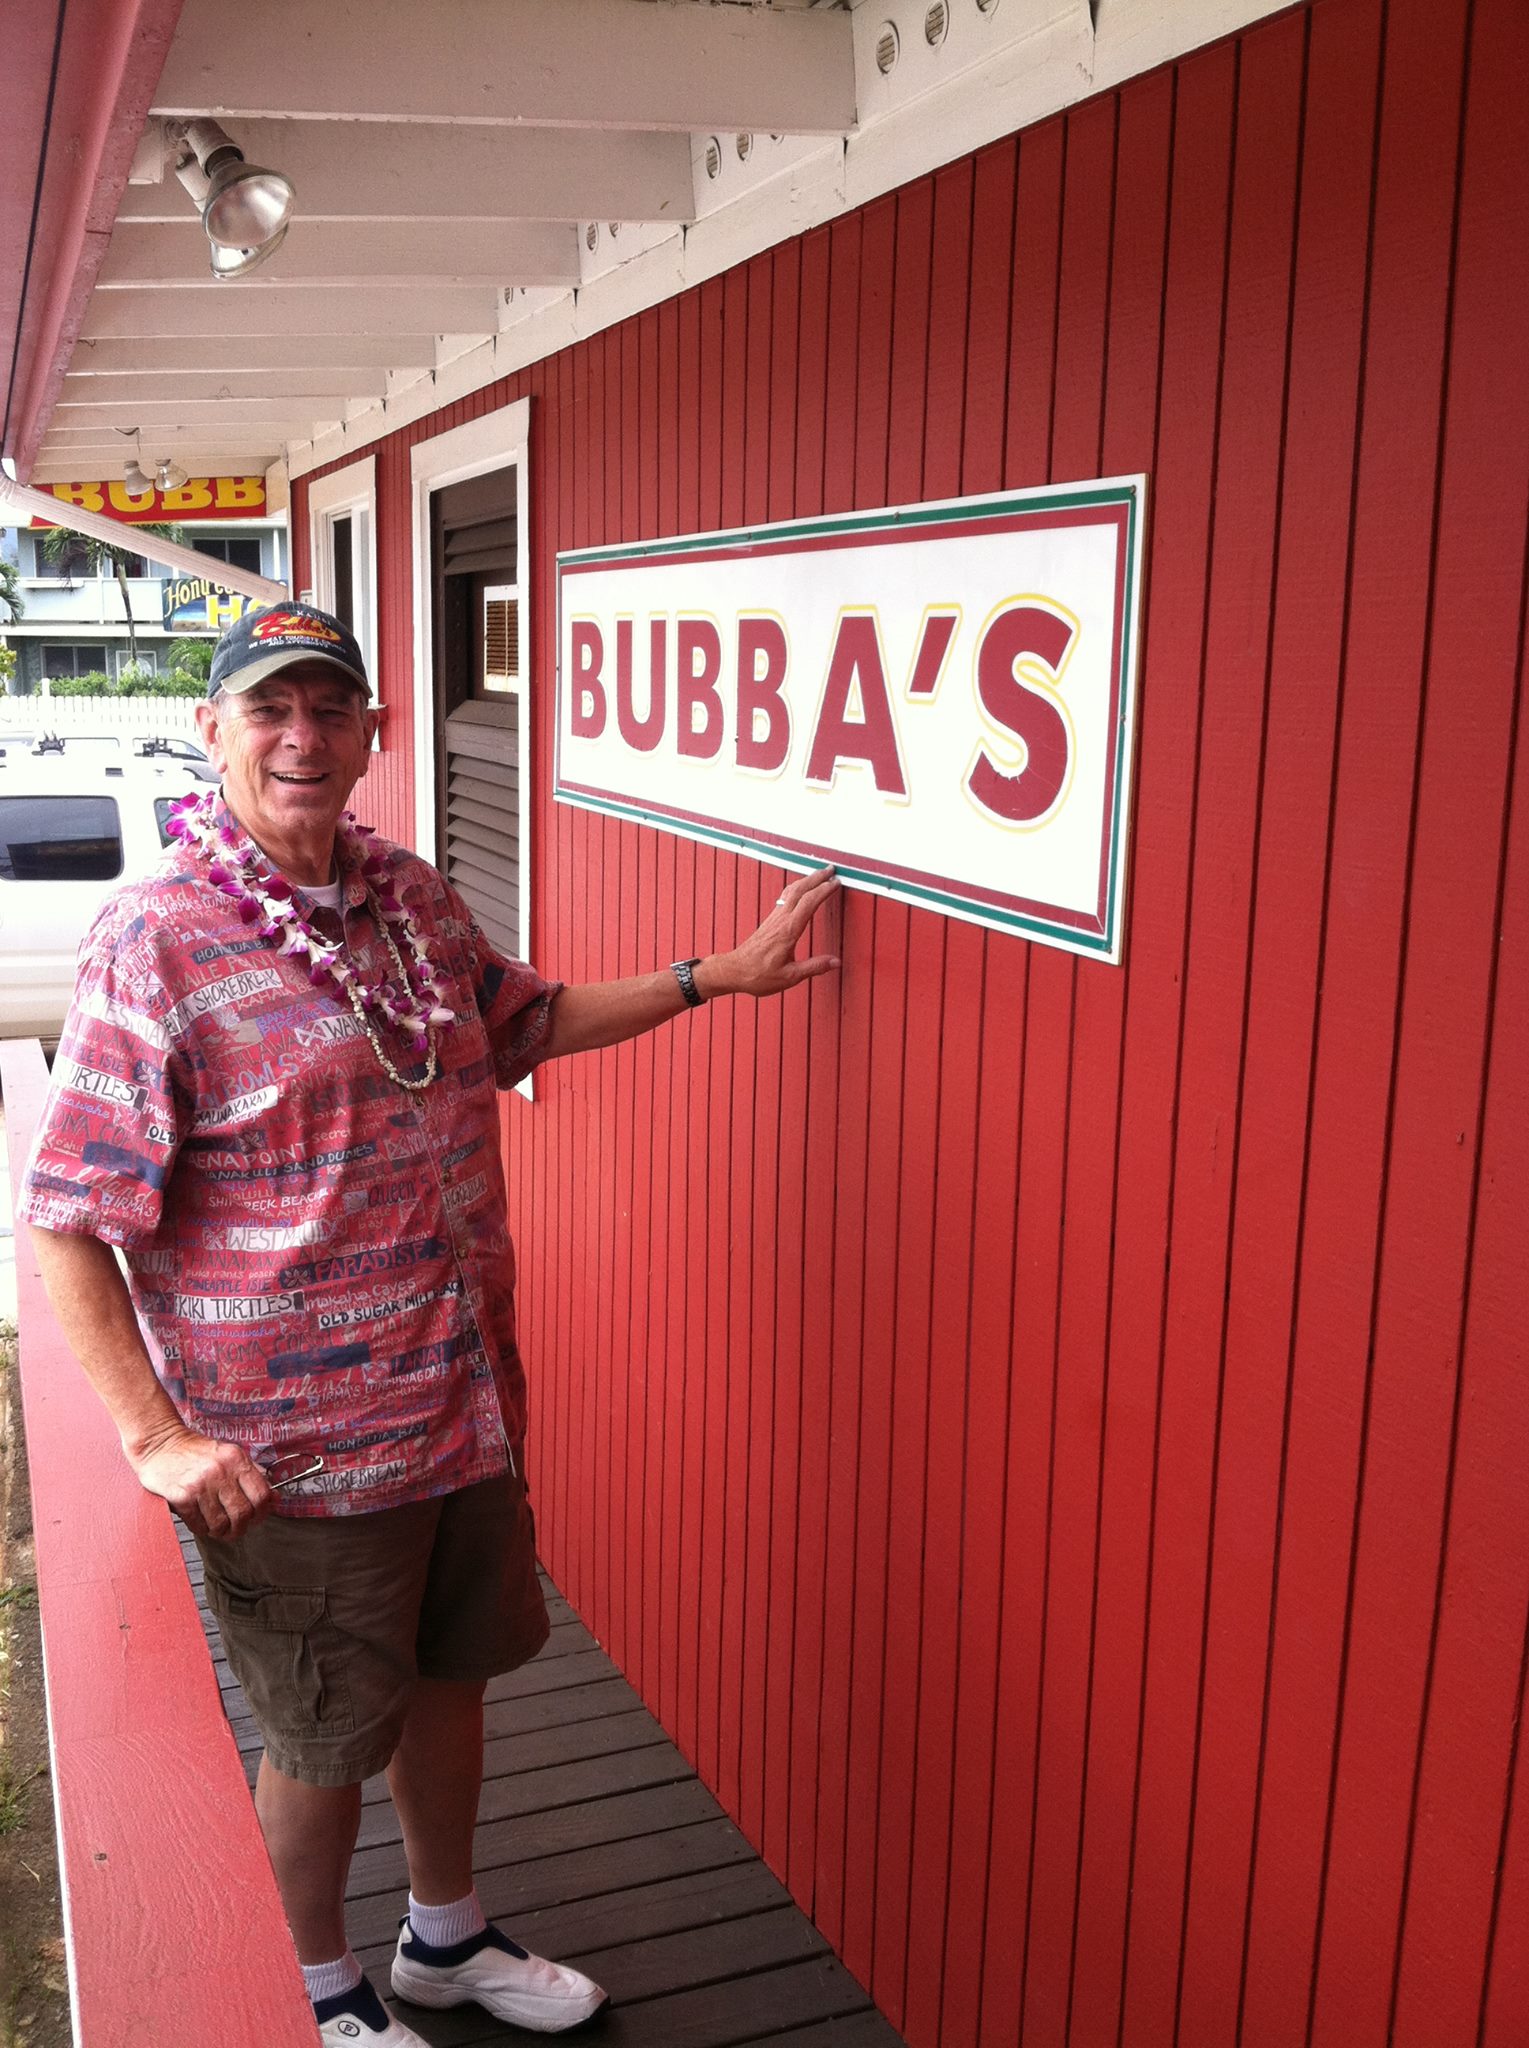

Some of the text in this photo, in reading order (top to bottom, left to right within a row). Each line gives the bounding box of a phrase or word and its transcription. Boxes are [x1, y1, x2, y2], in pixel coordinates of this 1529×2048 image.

[569, 593, 1080, 832] BUBBA'S
[193, 968, 281, 1012] SHOREBREAK
[221, 1052, 299, 1099] BOWLS
[148, 1125, 175, 1146] OLD
[312, 1127, 351, 1145] Secret
[243, 1143, 308, 1166] POINT
[283, 1154, 324, 1174] SAND
[113, 1197, 156, 1217] IRMA'S
[227, 1228, 281, 1251] WEST
[359, 1241, 388, 1252] Ewa
[392, 1230, 428, 1248] beach
[314, 1242, 427, 1282] PARADISE
[186, 1277, 273, 1294] PINEAPPLE ISLE
[210, 1293, 293, 1320] TURTLES
[319, 1314, 350, 1328] OLD
[353, 1302, 401, 1322] SUGAR
[321, 1382, 361, 1403] IRMA'S
[328, 1423, 426, 1451] HONOLUA BAY
[311, 1463, 406, 1496] SHOREBREAK
